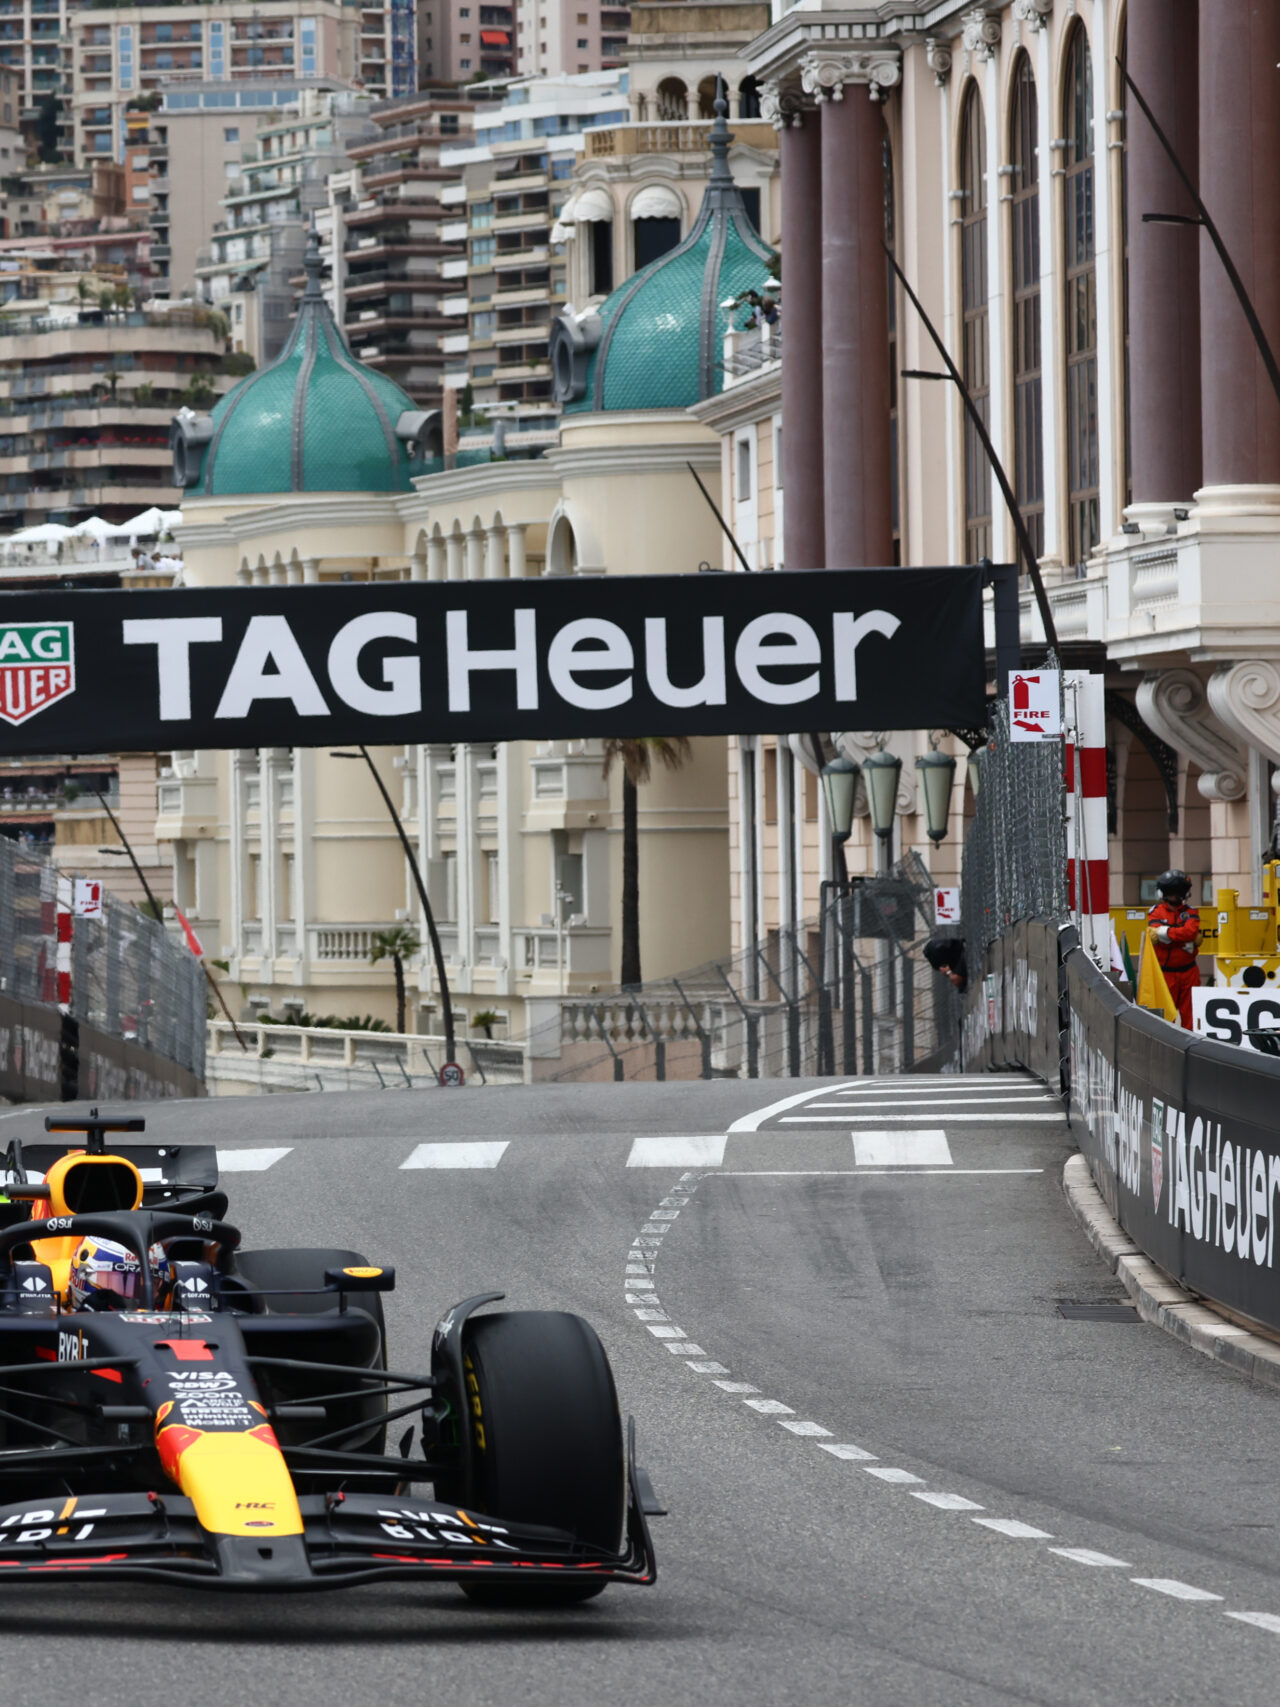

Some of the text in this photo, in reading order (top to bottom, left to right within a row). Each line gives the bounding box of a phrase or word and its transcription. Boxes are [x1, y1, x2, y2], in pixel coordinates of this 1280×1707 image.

[1013, 711, 1051, 719] FIRE
[165, 1372, 234, 1380] VISA
[174, 1391, 243, 1399] zoom
[235, 1502, 277, 1510] HRC
